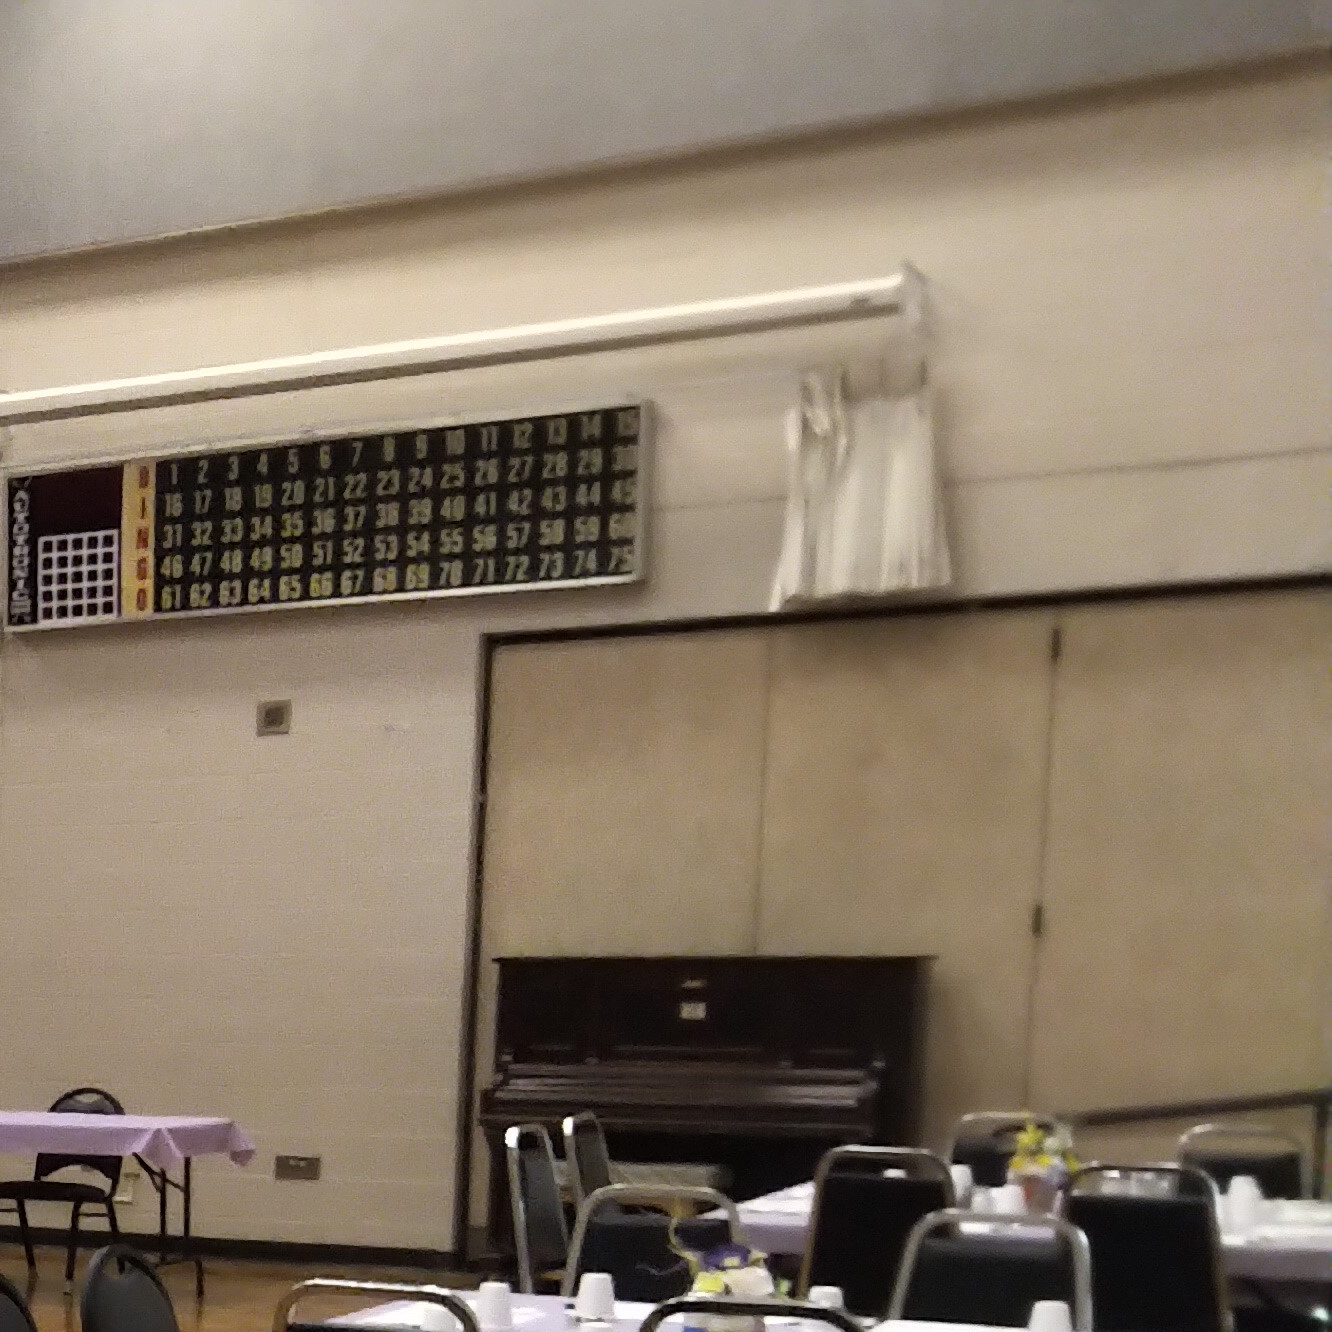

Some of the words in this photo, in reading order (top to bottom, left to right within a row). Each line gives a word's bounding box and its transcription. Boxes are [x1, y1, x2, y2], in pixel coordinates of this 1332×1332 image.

[170, 464, 178, 484] 1
[198, 459, 208, 483] 2
[228, 456, 238, 480] 3
[257, 453, 268, 475] 4
[288, 450, 298, 473] 5
[320, 448, 331, 469] 6
[352, 441, 362, 466] 7
[481, 426, 499, 452] 11
[194, 489, 212, 514] 17
[254, 484, 272, 508] 19
[281, 481, 304, 506] 20
[313, 476, 336, 502] 21
[344, 472, 367, 499] 22
[376, 469, 400, 496] 23
[408, 466, 433, 492] 24
[440, 461, 465, 488] 25
[475, 458, 498, 486] 26
[508, 456, 533, 482] 27
[542, 451, 568, 478] 28
[163, 524, 182, 548] 31
[191, 521, 212, 546] 32
[221, 517, 243, 543] 33
[250, 514, 272, 540] 34
[280, 510, 303, 538] 35
[311, 508, 336, 534] 36
[344, 505, 366, 531] 37
[408, 498, 432, 524] 39
[440, 495, 466, 521] 40
[474, 491, 496, 518] 41
[508, 488, 532, 515] 42
[542, 486, 567, 512] 43
[576, 482, 600, 506] 44
[161, 554, 183, 579] 46
[190, 551, 212, 577] 47
[220, 548, 243, 573] 48
[250, 546, 272, 571] 49
[280, 543, 303, 569] 50
[312, 540, 333, 564] 51
[342, 537, 365, 564] 52
[374, 535, 398, 561] 53
[406, 531, 430, 558] 54
[440, 528, 464, 554] 55
[472, 524, 497, 552] 56
[506, 522, 530, 548] 57
[574, 516, 600, 542] 59
[161, 585, 181, 610] 61
[190, 582, 212, 607] 62
[248, 578, 270, 602] 64
[279, 575, 302, 600] 65
[310, 571, 333, 596] 66
[340, 569, 364, 596] 67
[405, 562, 430, 590] 69
[439, 560, 464, 586] 70
[472, 558, 496, 584] 71
[504, 555, 530, 581] 72
[539, 552, 564, 578] 73
[572, 548, 598, 576] 74
[608, 546, 634, 572] 75
